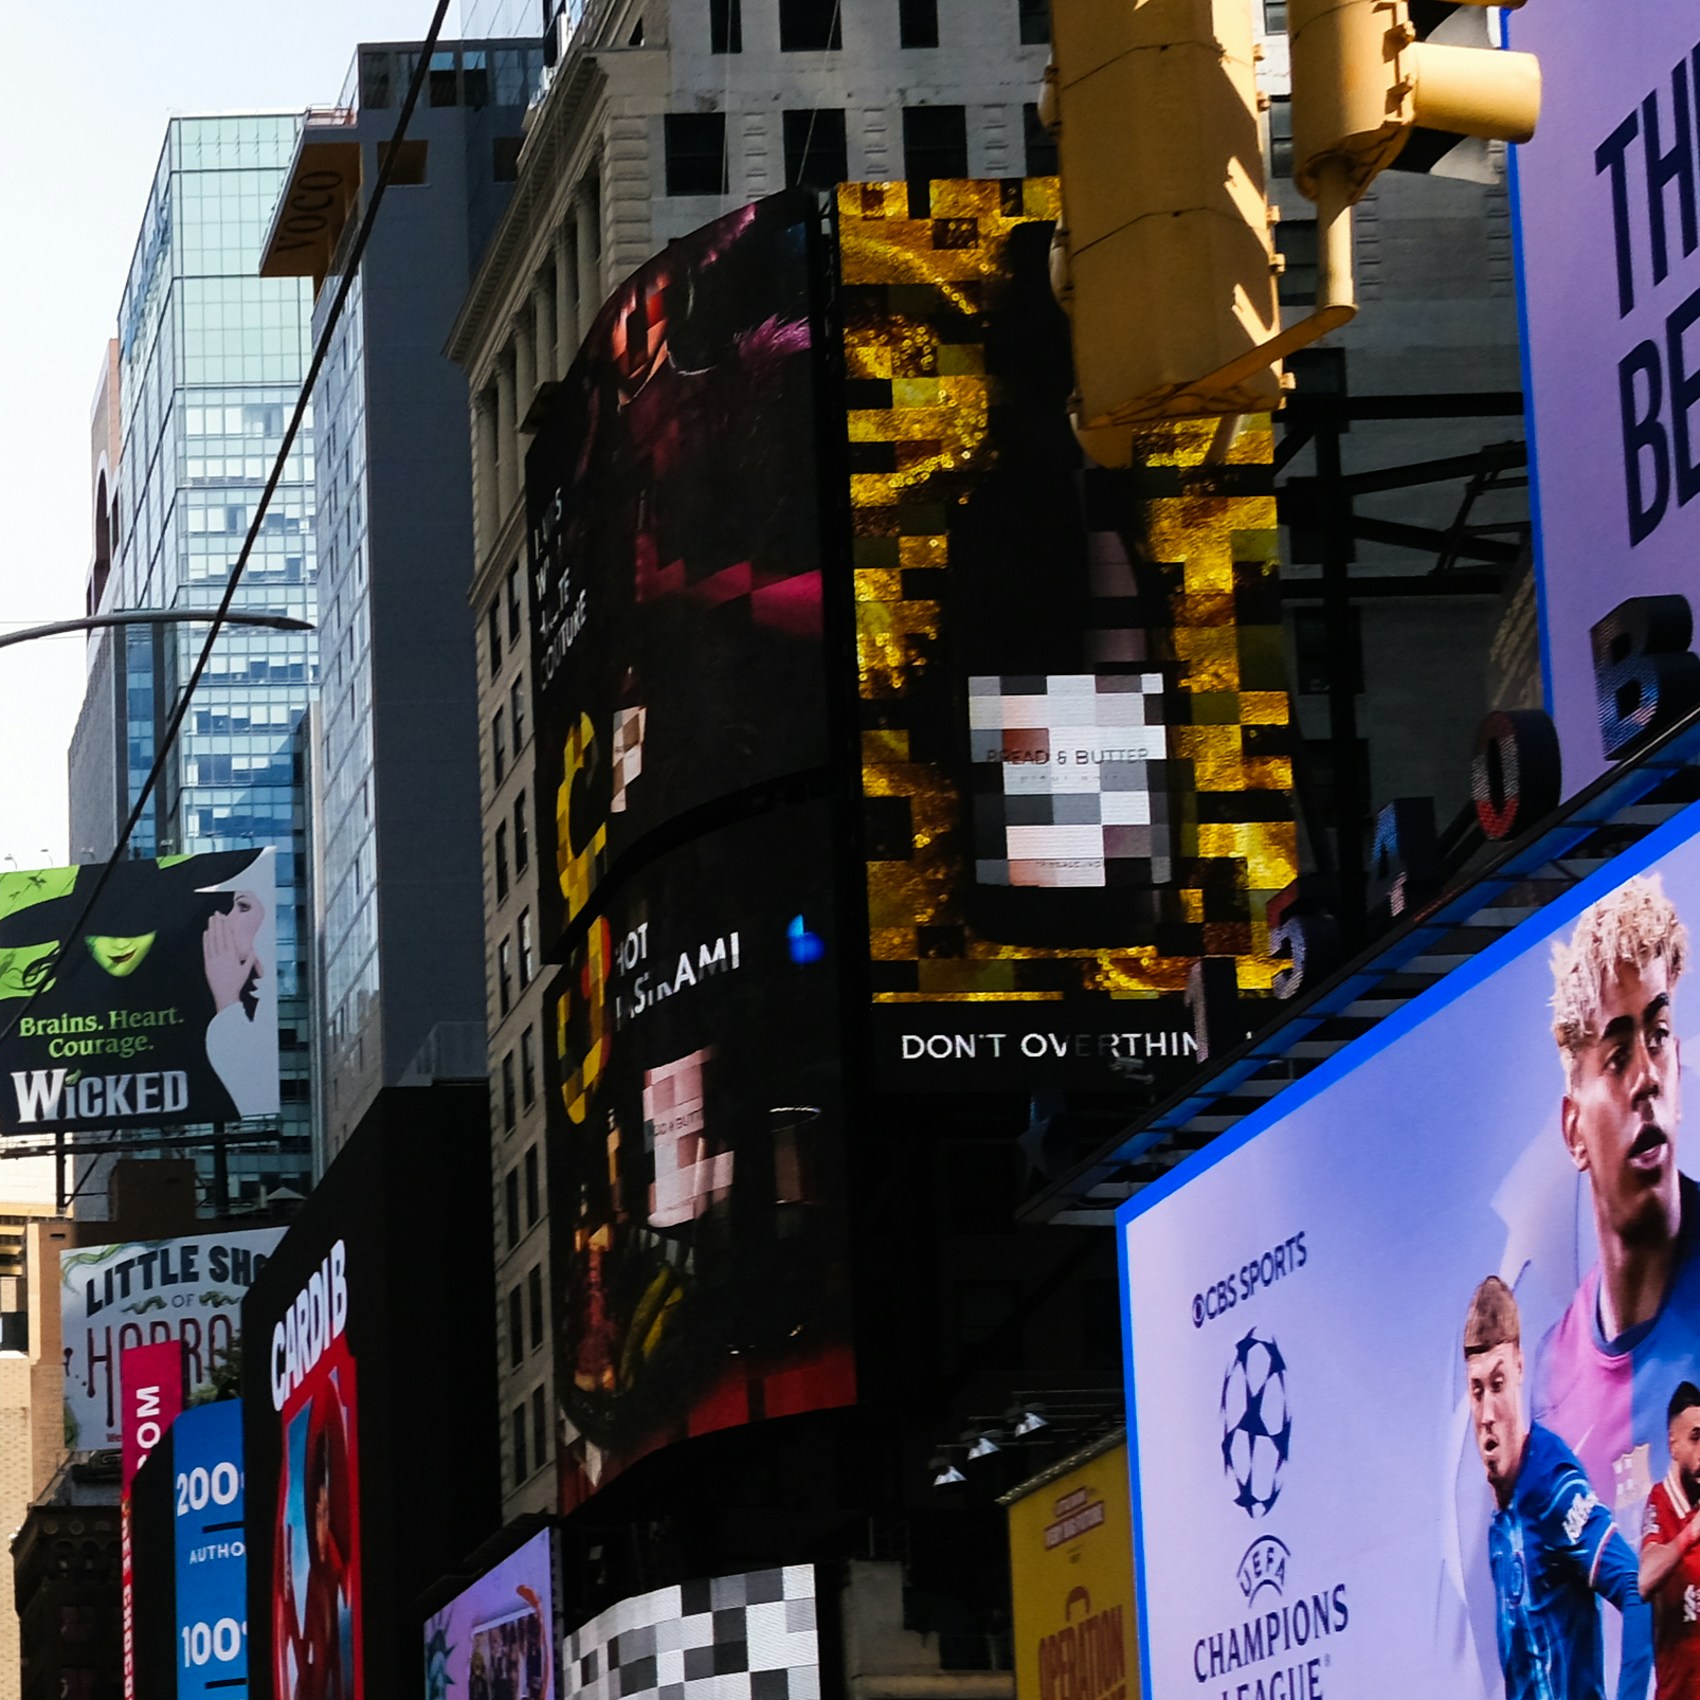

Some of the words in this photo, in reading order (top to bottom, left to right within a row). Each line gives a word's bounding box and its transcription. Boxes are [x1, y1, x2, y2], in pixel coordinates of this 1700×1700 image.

[1075, 747, 1150, 765] BUTTER
[19, 1012, 105, 1038] Brains.
[108, 1006, 185, 1030] Heart.
[48, 1033, 154, 1059] Courage.
[901, 1032, 1007, 1060] DON'T
[86, 1245, 200, 1319] LITTLE
[1205, 1272, 1238, 1322] CBS
[1239, 1231, 1309, 1300] SPORTS
[170, 1293, 196, 1309] OF
[1193, 1582, 1349, 1684] CHAMPIONS
